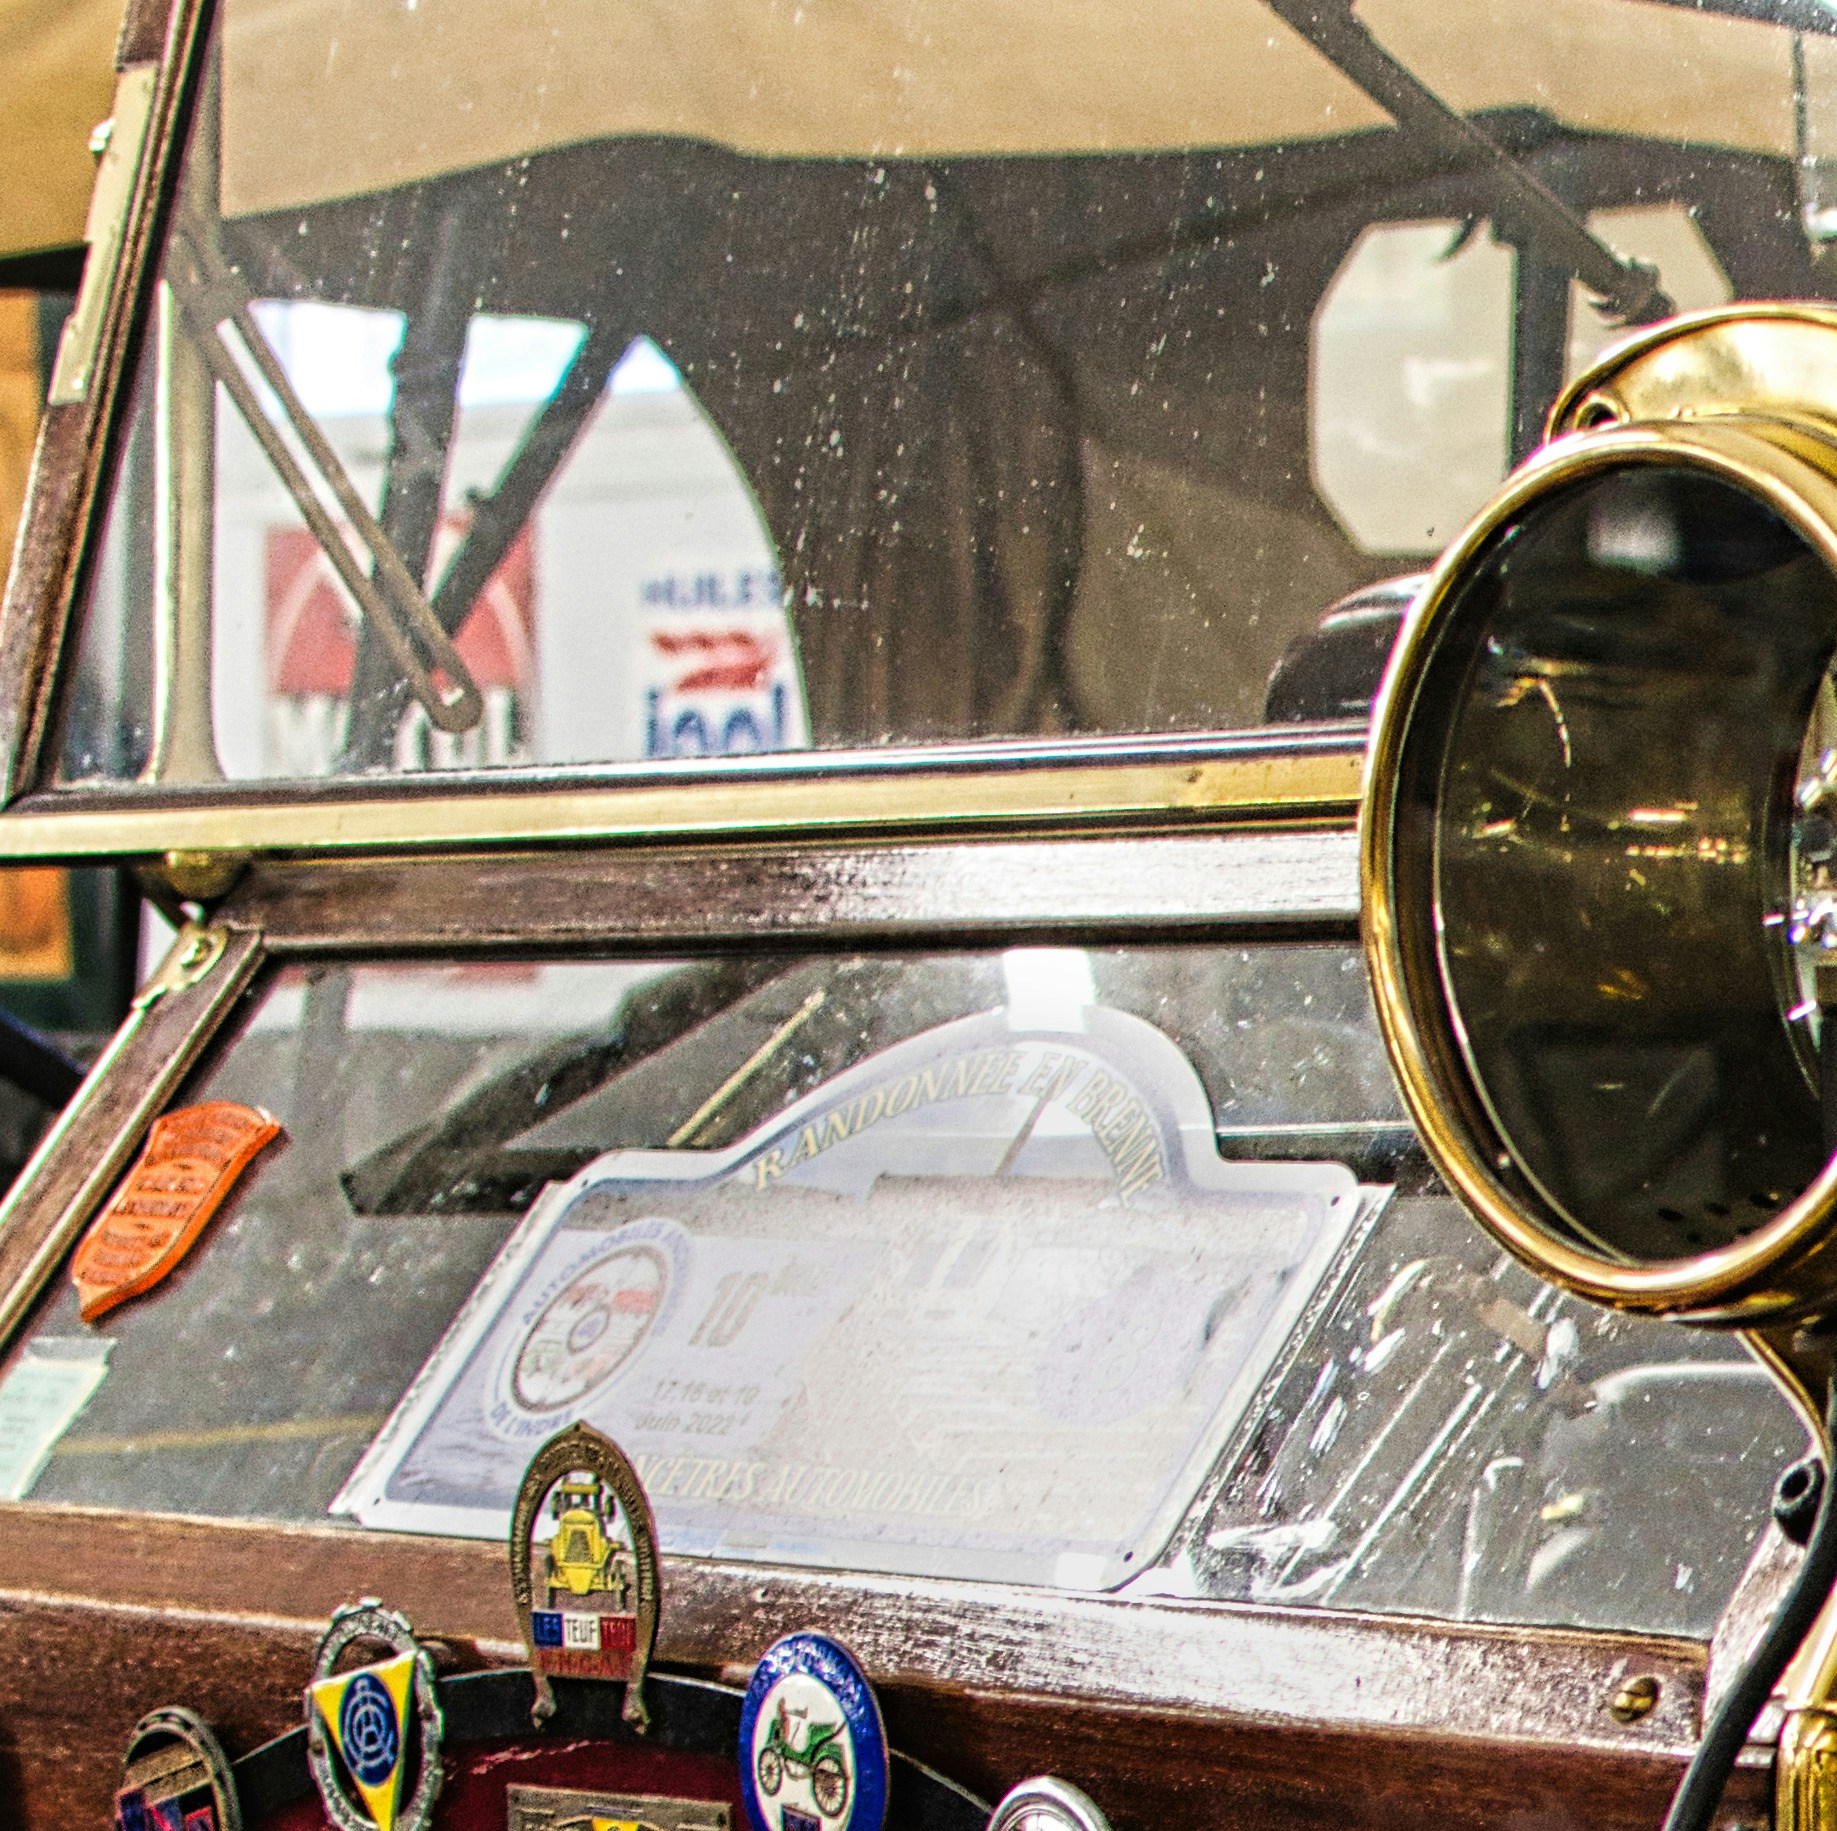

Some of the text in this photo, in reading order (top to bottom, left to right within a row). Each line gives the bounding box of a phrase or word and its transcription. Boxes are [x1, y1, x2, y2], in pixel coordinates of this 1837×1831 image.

[1017, 1051, 1089, 1101] EN
[1066, 1067, 1168, 1199] BRENNE
[681, 1411, 736, 1436] 2022
[634, 1449, 766, 1501] NCÊTRES
[565, 1617, 597, 1643] TEUF
